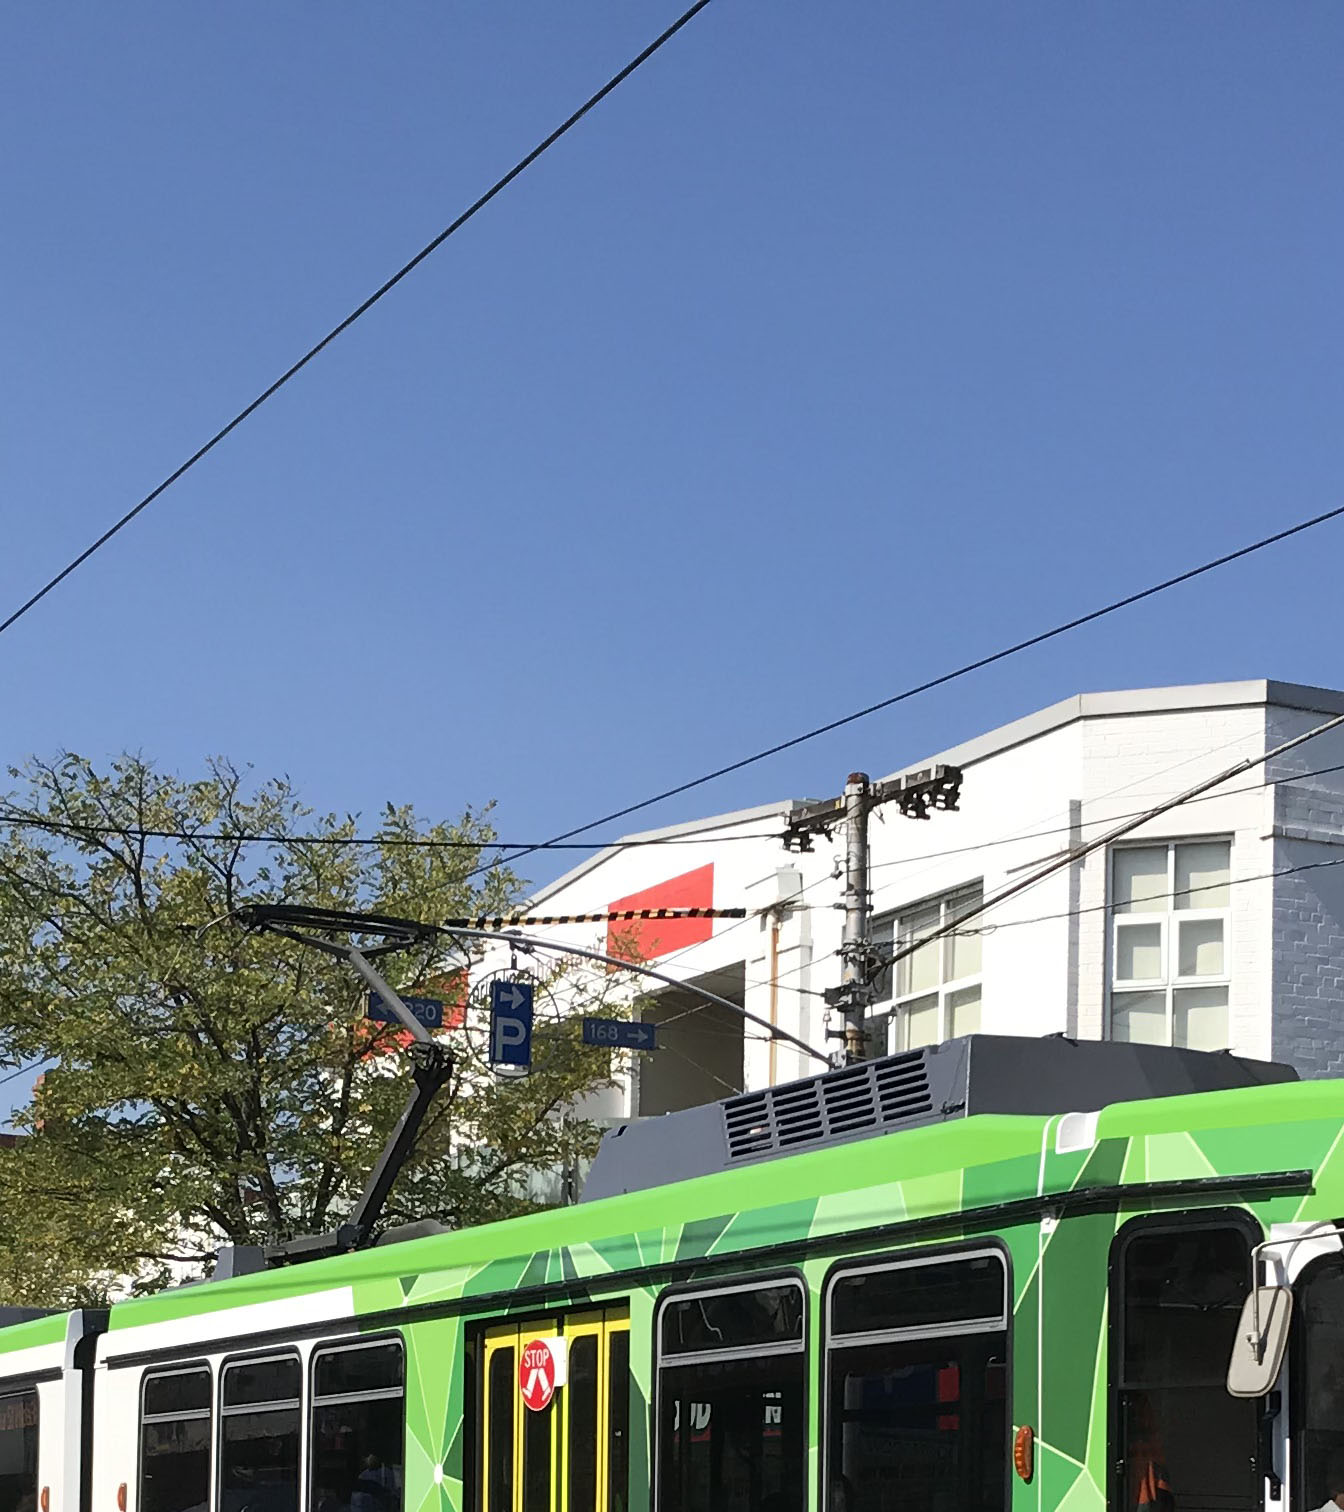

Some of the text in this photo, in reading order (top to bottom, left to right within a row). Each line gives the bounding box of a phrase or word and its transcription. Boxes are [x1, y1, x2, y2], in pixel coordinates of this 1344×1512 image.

[495, 1016, 526, 1060] P
[590, 1024, 618, 1040] 168
[524, 1348, 550, 1368] STOP
